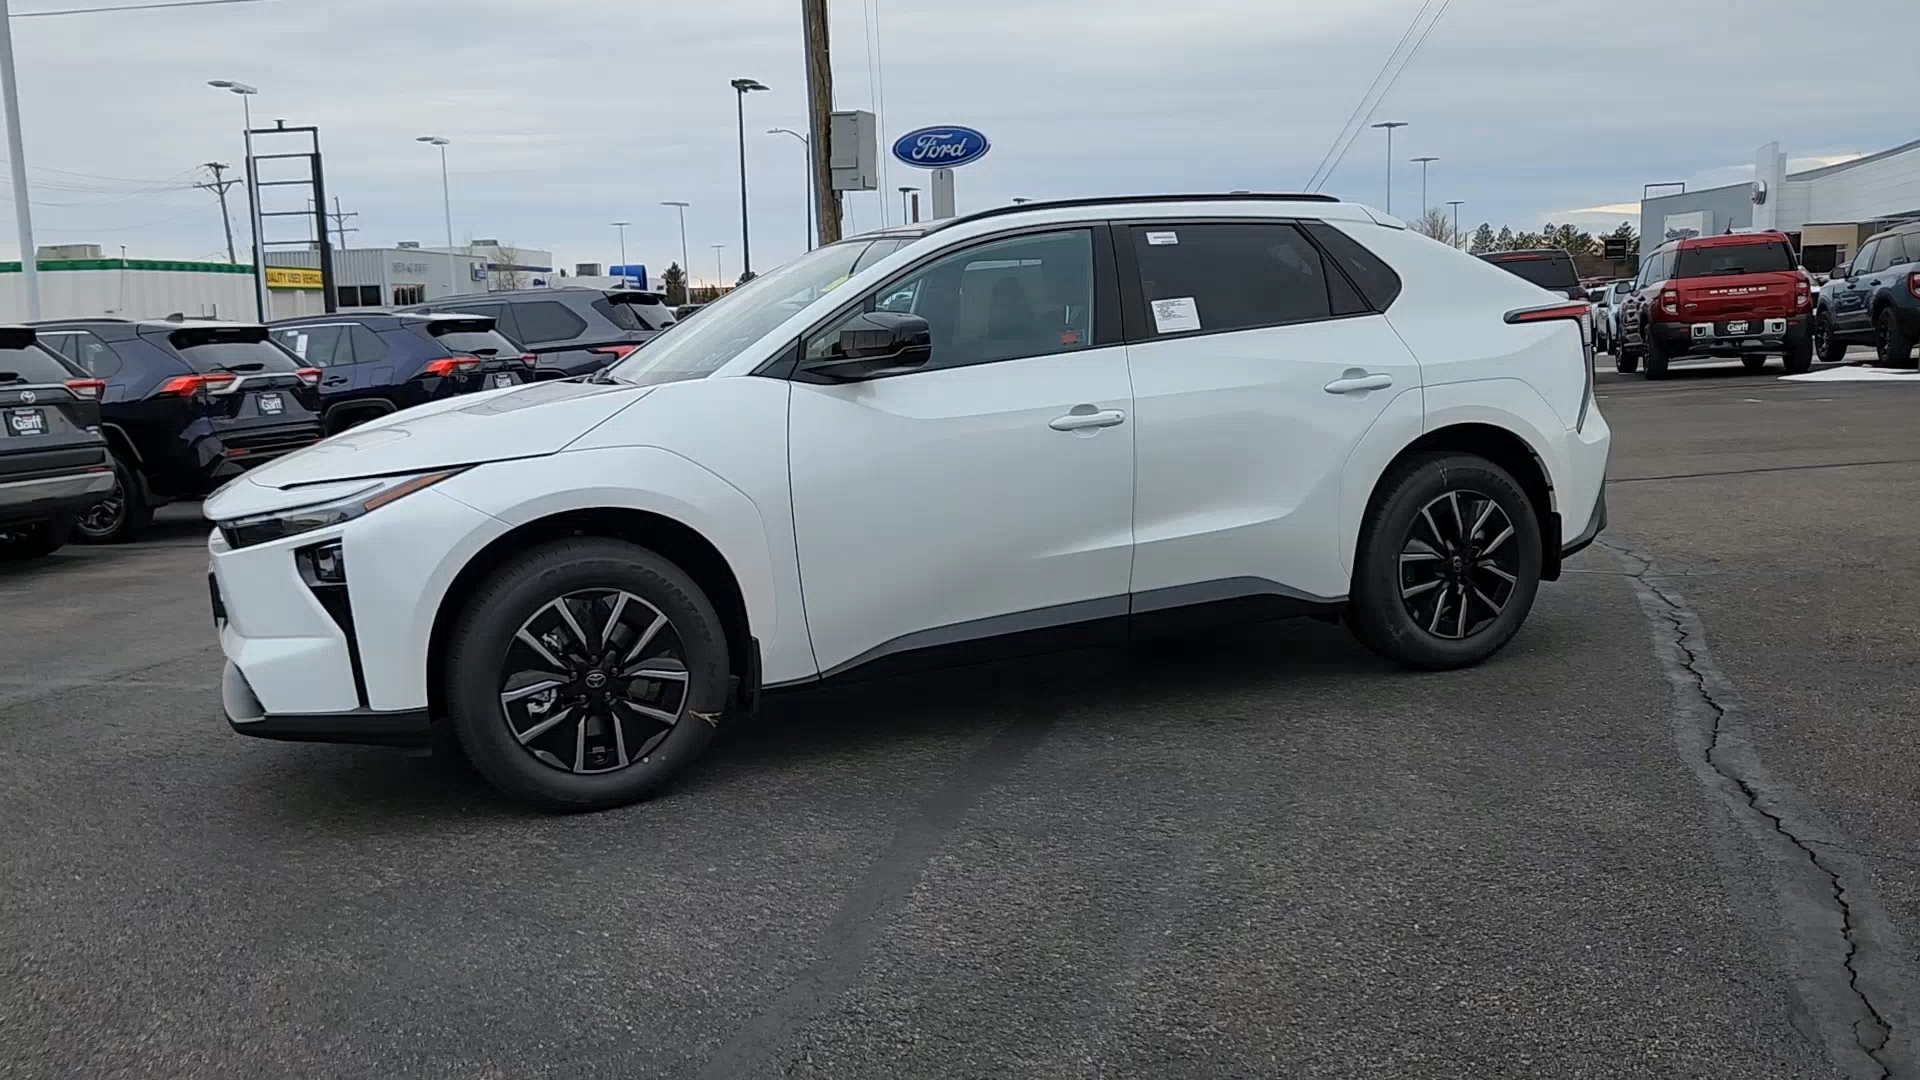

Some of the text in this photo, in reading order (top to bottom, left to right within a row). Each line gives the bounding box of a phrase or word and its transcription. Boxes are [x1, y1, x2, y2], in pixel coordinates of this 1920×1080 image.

[912, 134, 967, 159] Ford
[266, 271, 287, 283] UALITY
[302, 273, 321, 285] VEHICL
[1727, 322, 1749, 332] Garff
[12, 415, 42, 430] Garff
